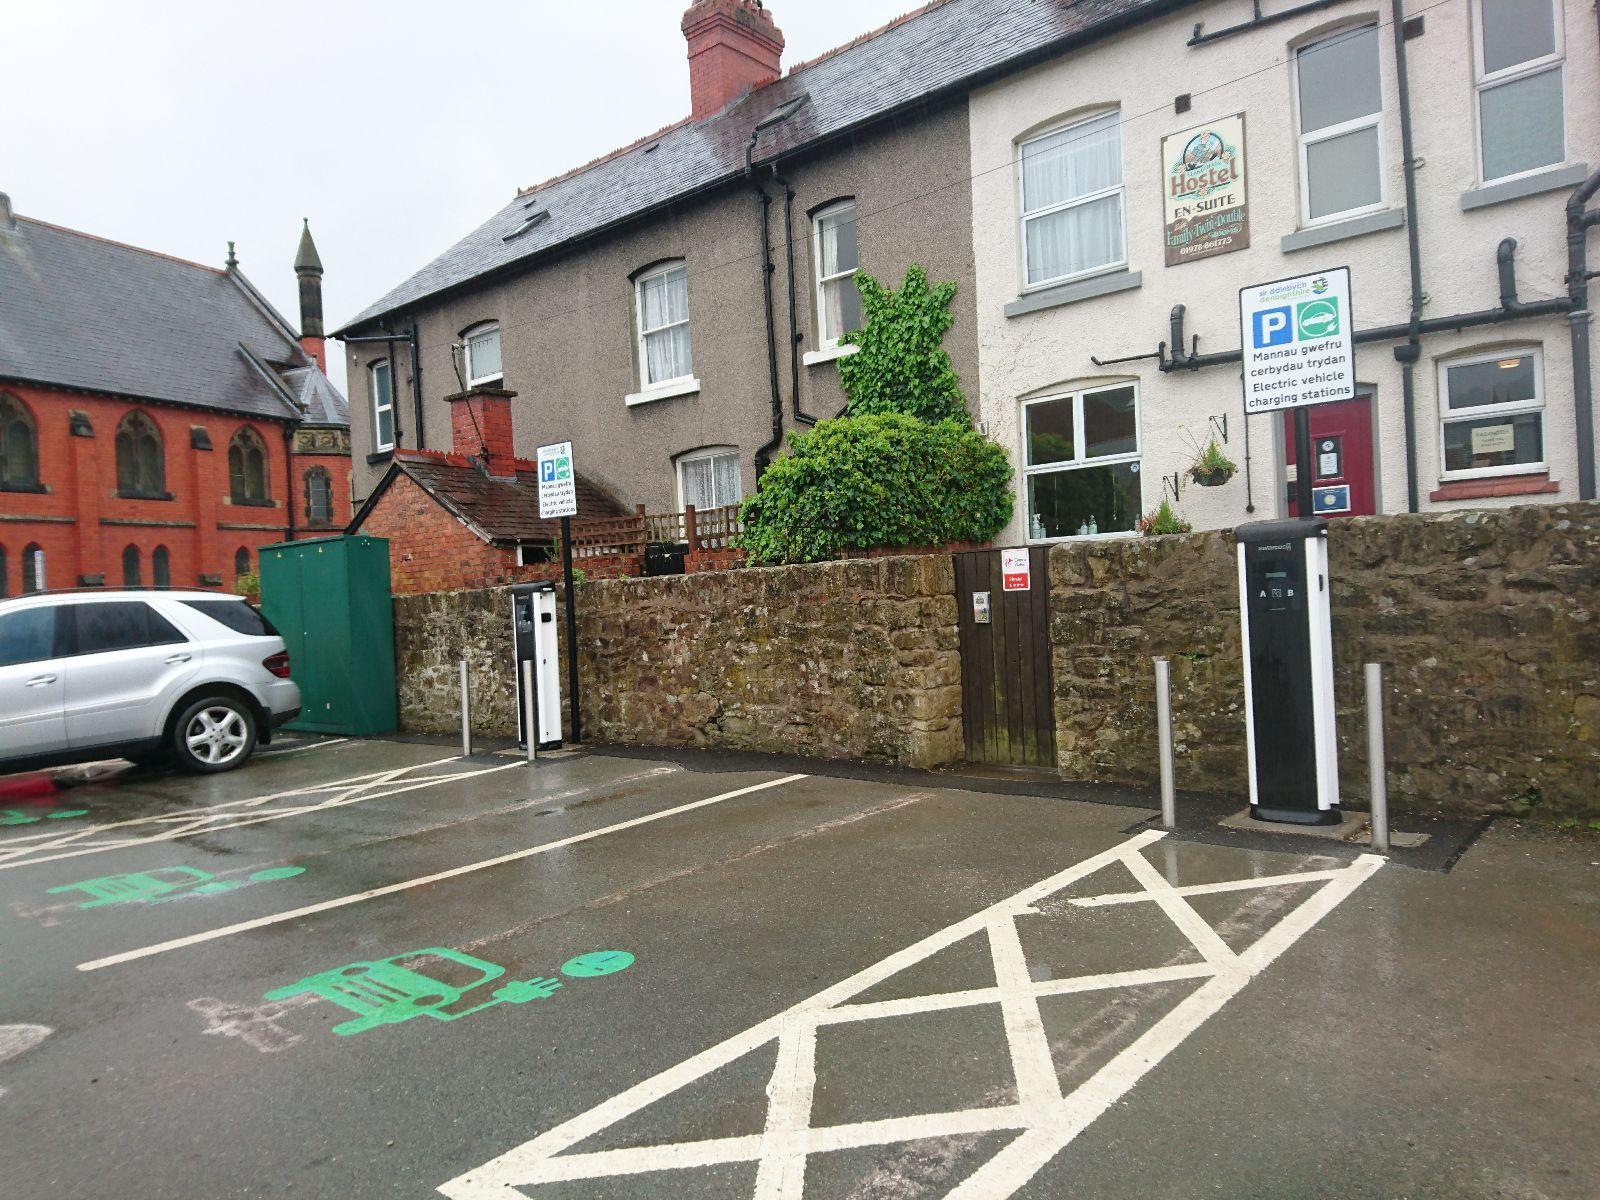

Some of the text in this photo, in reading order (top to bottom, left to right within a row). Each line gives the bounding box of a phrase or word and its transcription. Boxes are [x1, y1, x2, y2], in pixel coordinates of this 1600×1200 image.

[1171, 157, 1239, 196] Hostel
[1175, 193, 1236, 219] EN-SUITE
[1262, 311, 1287, 344] P
[1253, 340, 1342, 362] Mannau gwefru
[1250, 354, 1346, 377] cerbydau trydan
[1253, 371, 1345, 392] Electric vehicle
[1249, 385, 1351, 408] charging stations
